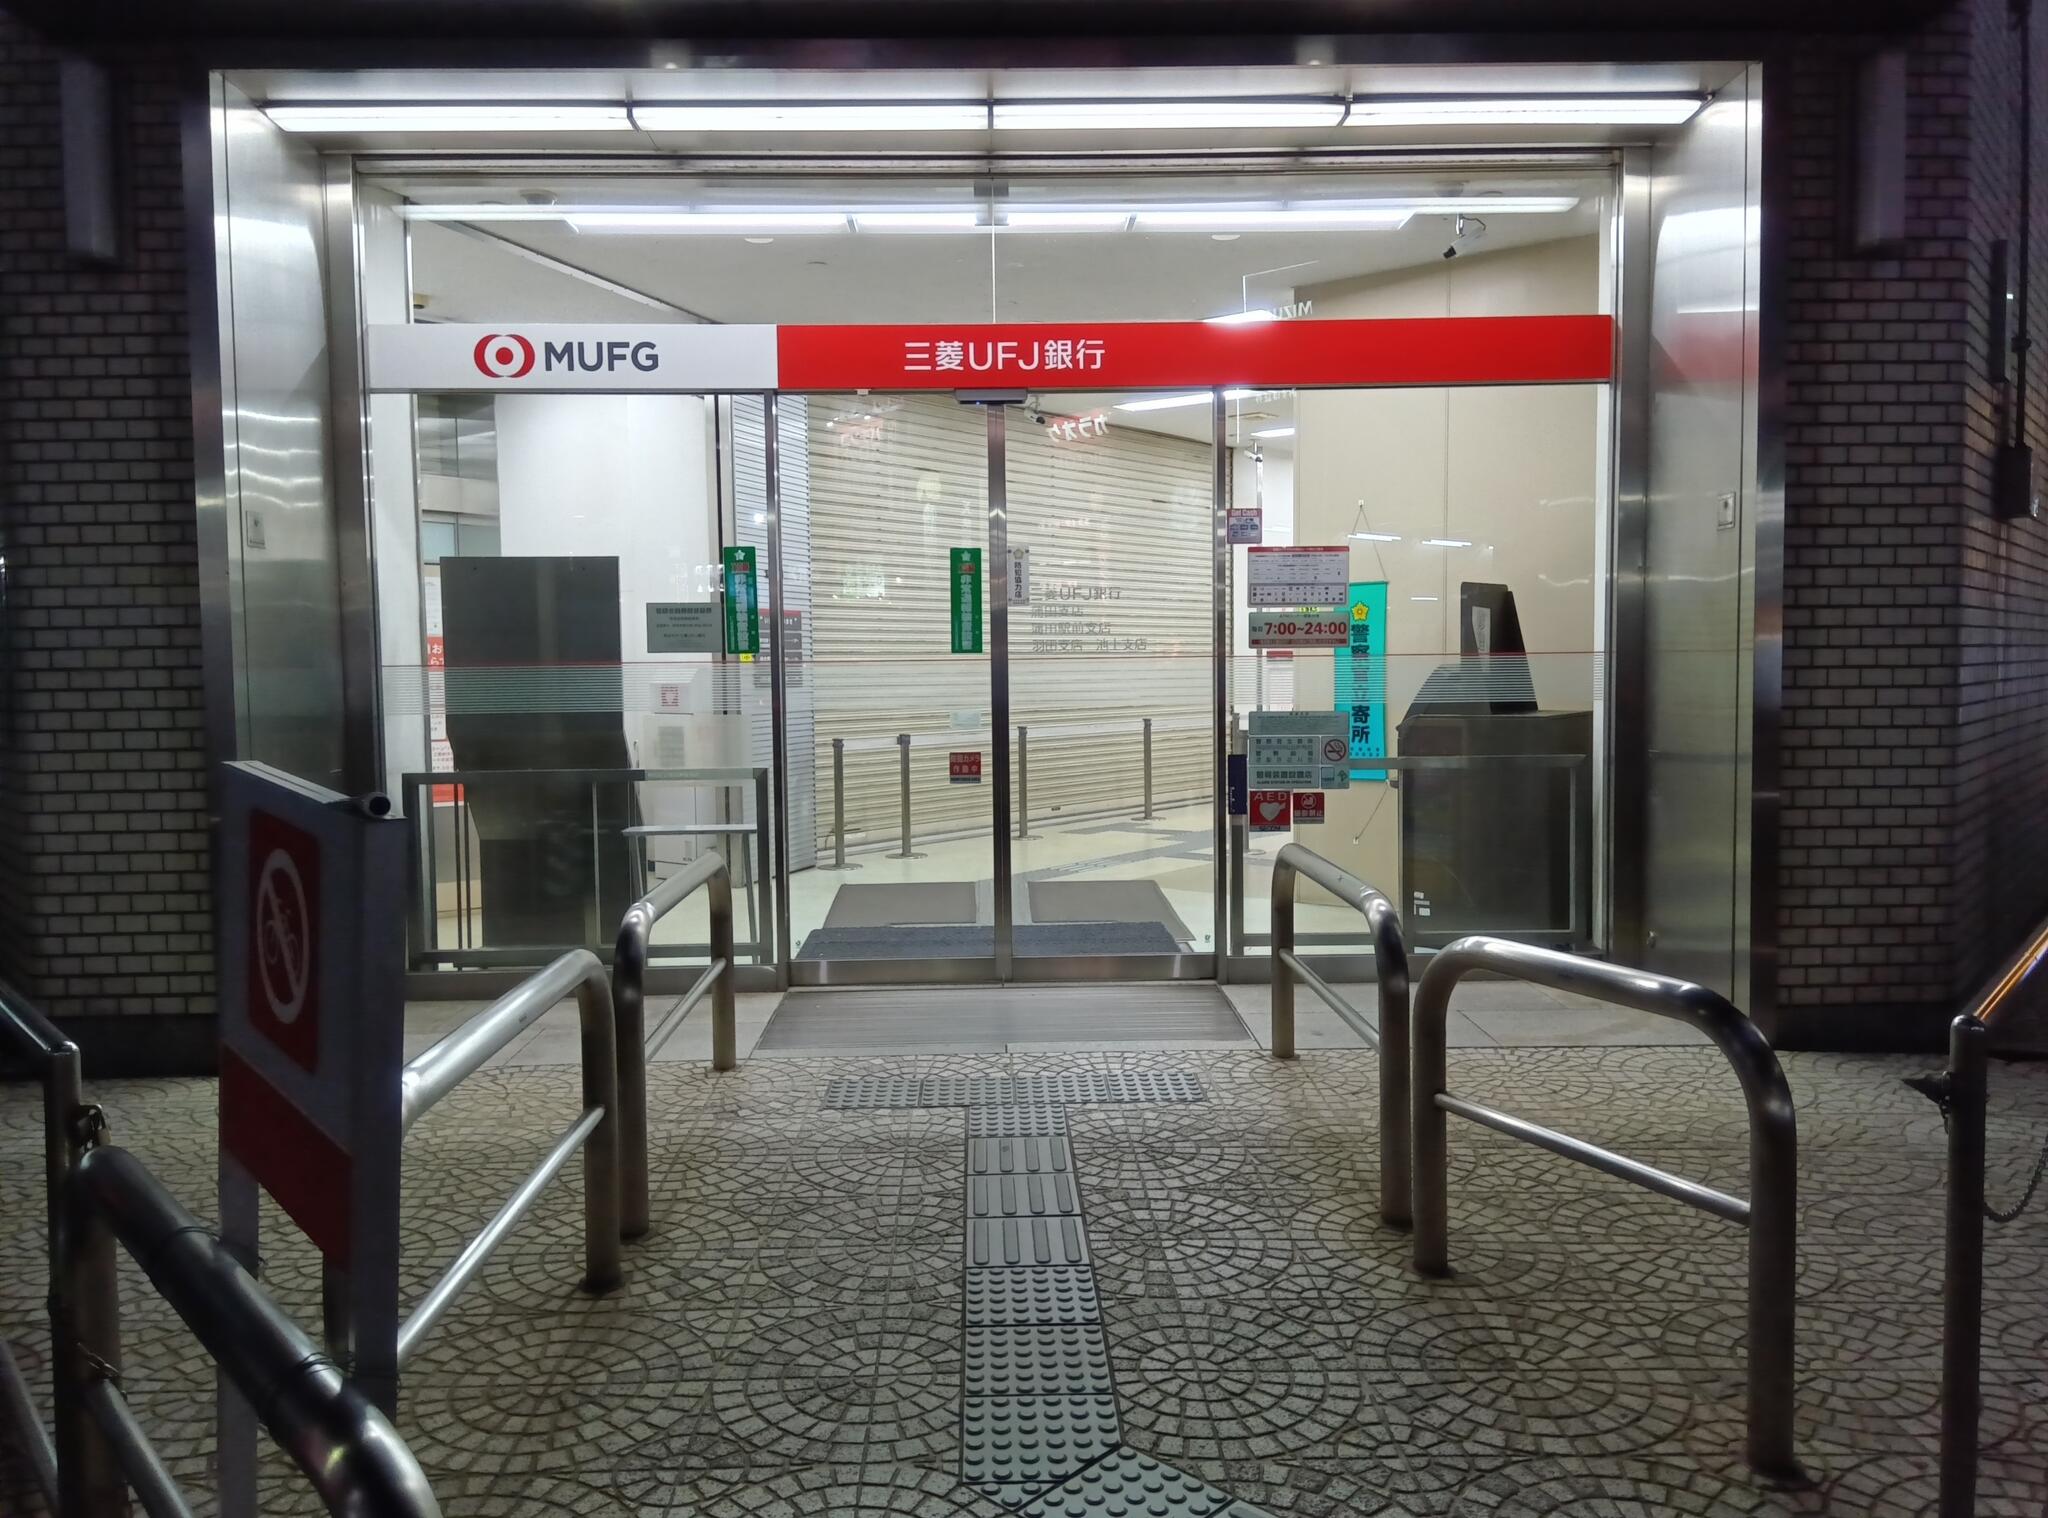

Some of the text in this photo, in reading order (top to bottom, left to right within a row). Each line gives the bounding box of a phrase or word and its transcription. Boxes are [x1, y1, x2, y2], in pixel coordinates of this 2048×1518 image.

[544, 341, 659, 372] MUFG
[904, 339, 1106, 371] 三菱UFJ銀行
[1350, 623, 1370, 744] 警察官立寄所
[1254, 792, 1287, 801] AED
